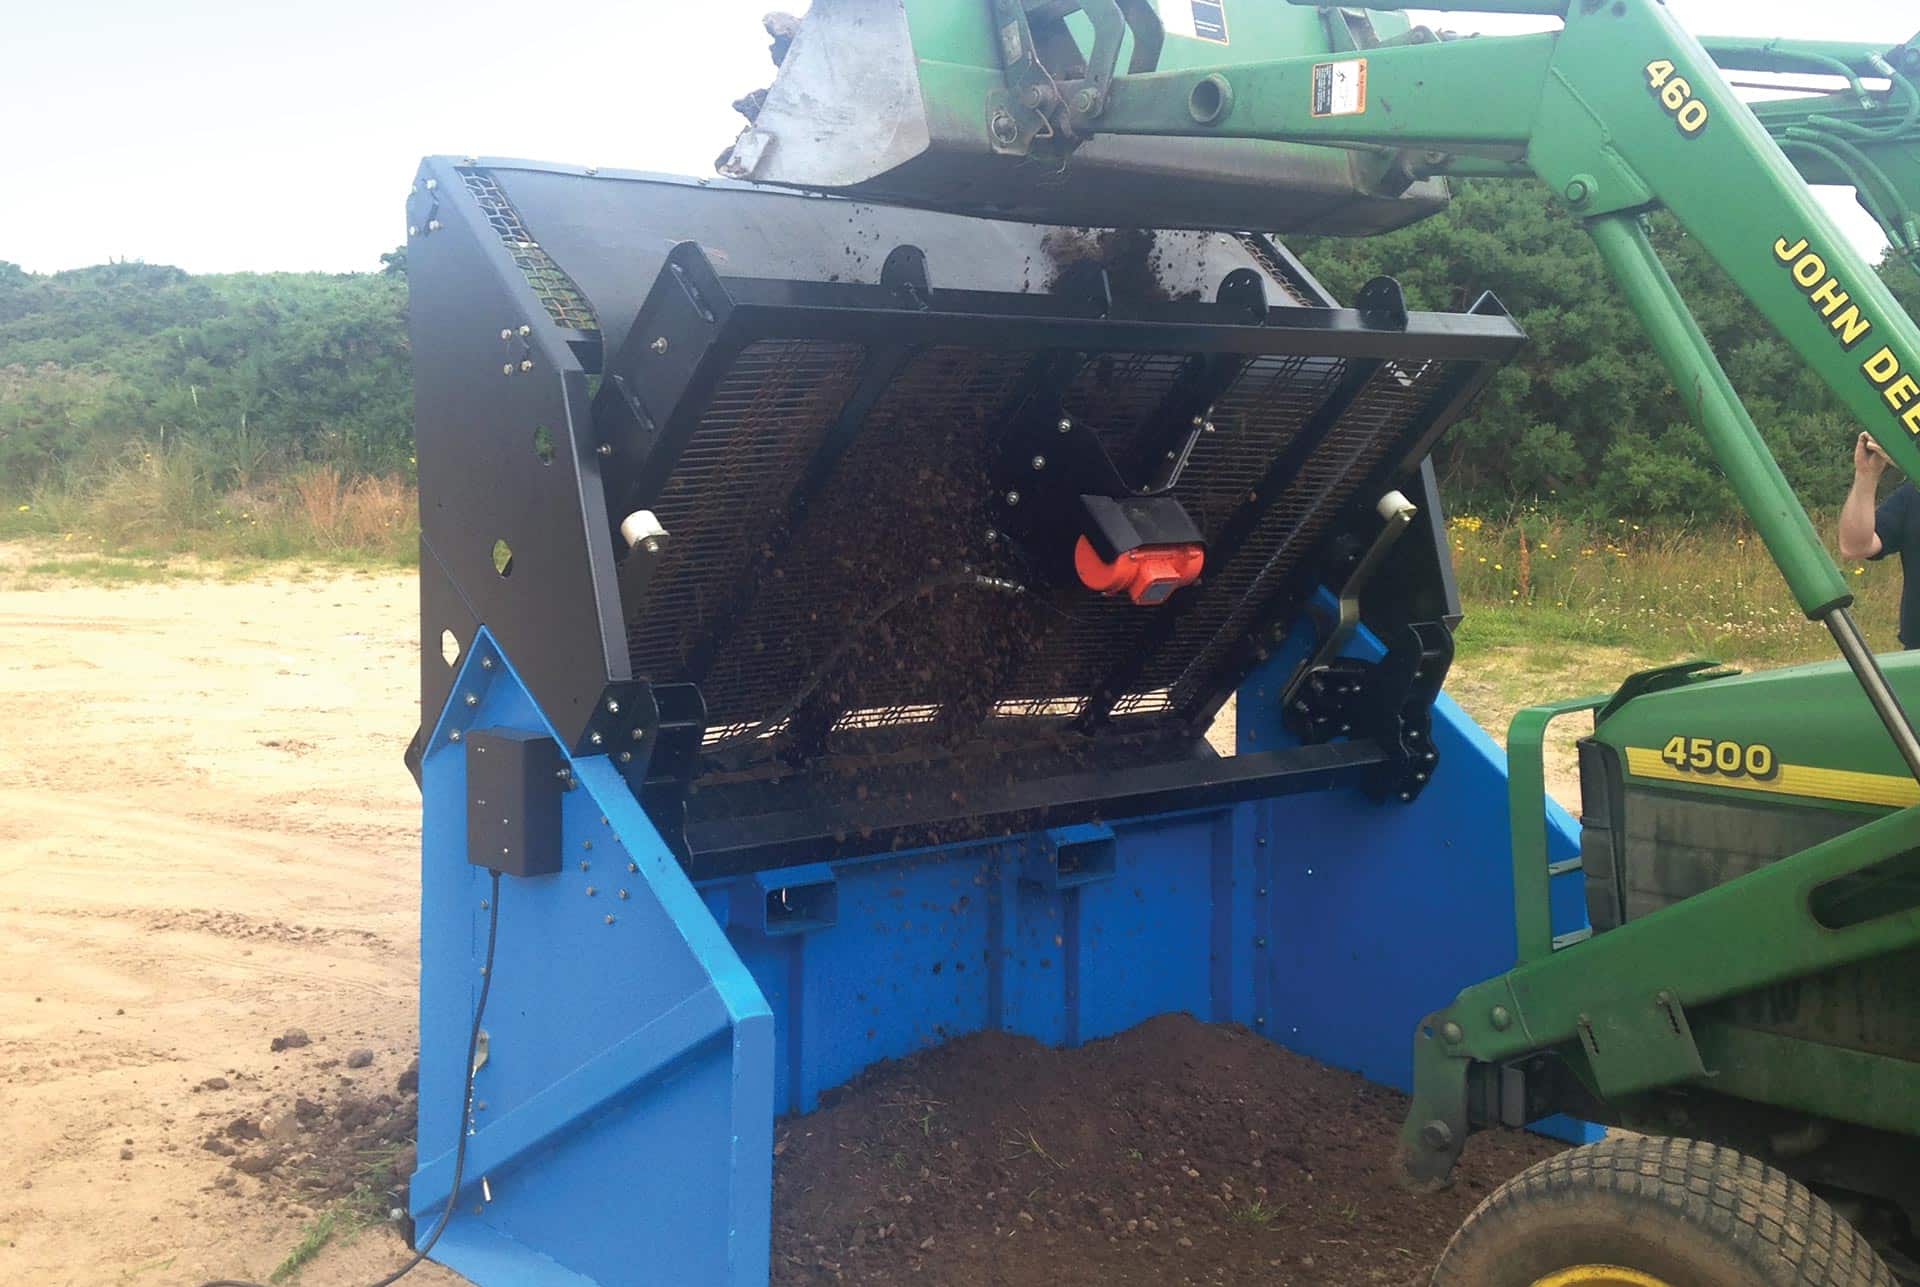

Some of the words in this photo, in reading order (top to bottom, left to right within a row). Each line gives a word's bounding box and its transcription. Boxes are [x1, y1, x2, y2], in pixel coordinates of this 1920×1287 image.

[1645, 58, 1709, 133] 460
[1773, 235, 1871, 346] JOHN
[1661, 735, 1773, 776] 4500
